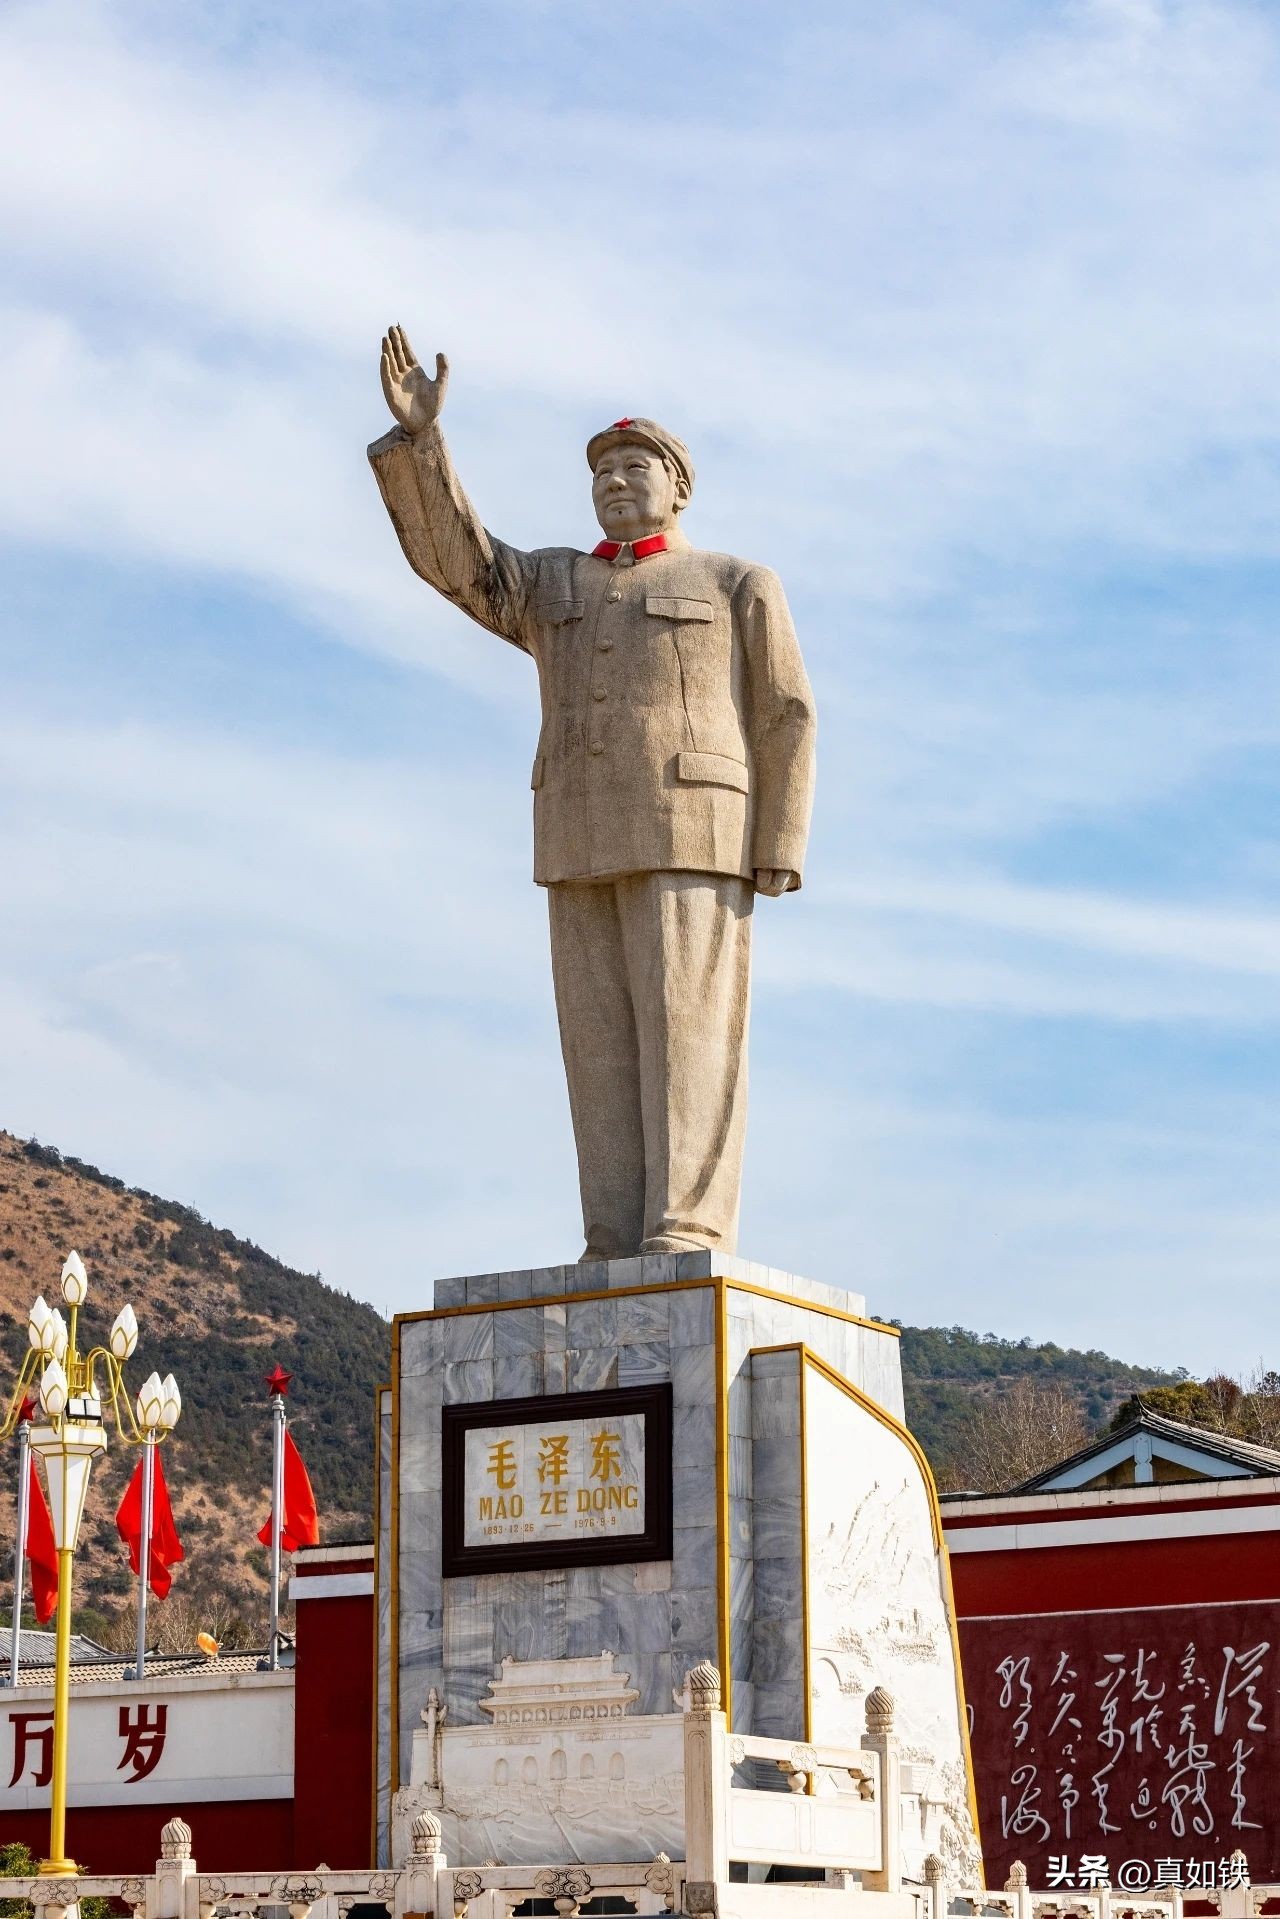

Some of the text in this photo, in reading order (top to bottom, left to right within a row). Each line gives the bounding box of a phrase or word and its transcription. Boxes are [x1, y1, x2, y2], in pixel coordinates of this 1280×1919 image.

[487, 1430, 622, 1490] 毛泽东
[479, 1485, 638, 1521] MAO ZE DONG
[8, 1704, 168, 1788] 万岁
